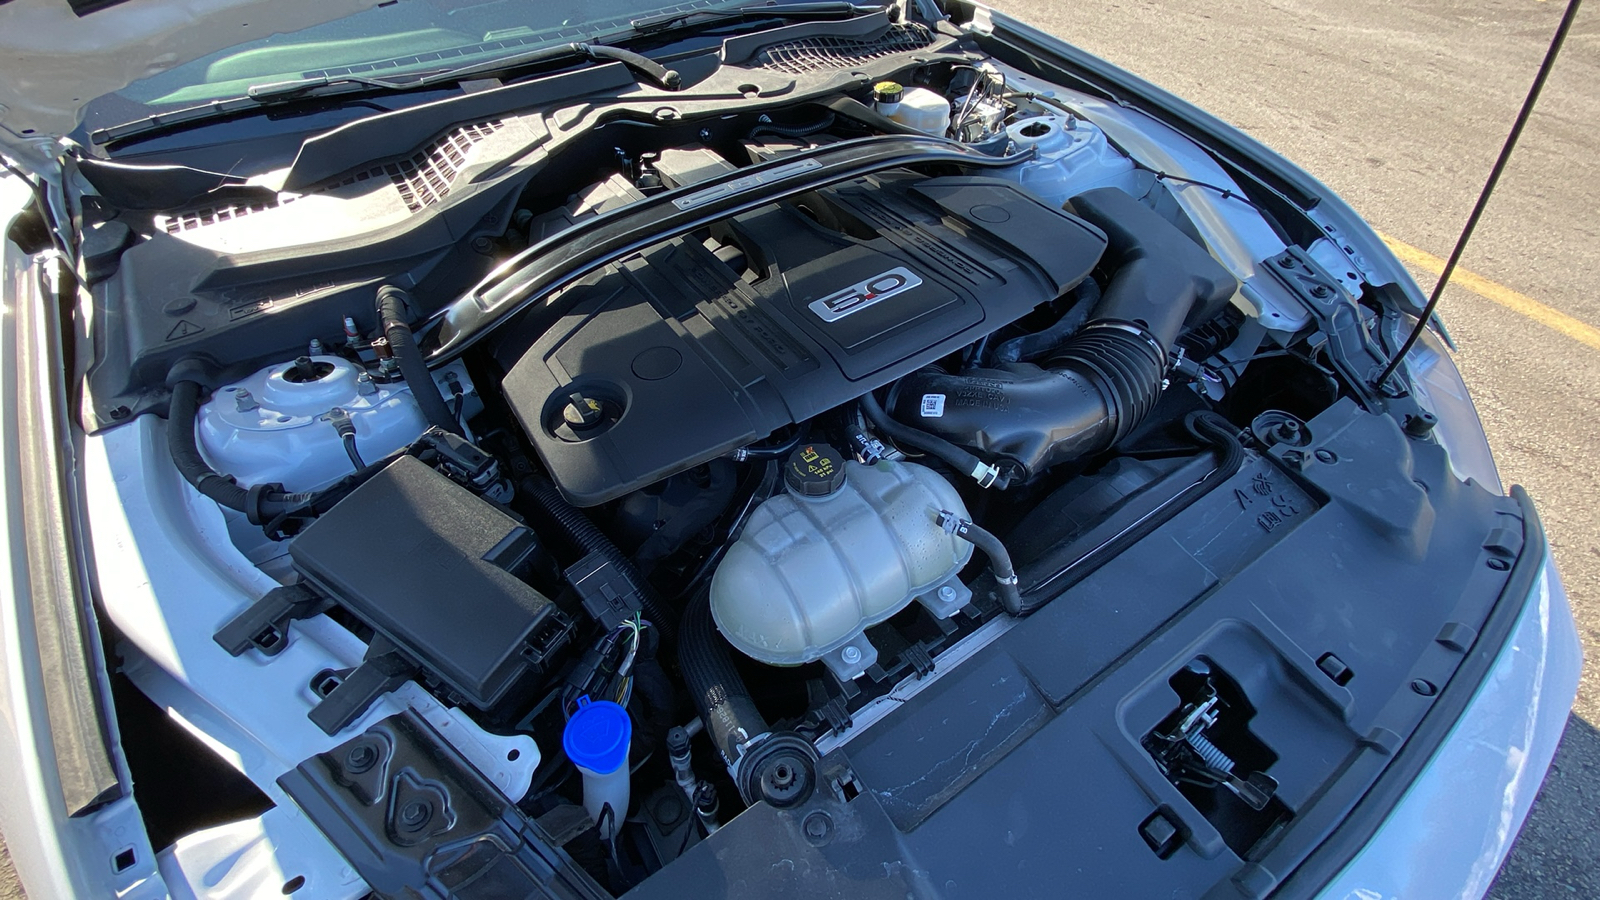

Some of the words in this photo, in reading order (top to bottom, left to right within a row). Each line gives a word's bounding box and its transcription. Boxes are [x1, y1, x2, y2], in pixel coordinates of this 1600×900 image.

[913, 235, 974, 275] POWERED
[822, 272, 908, 314] 5.0
[955, 397, 980, 408] MADE
[993, 403, 1010, 413] USA
